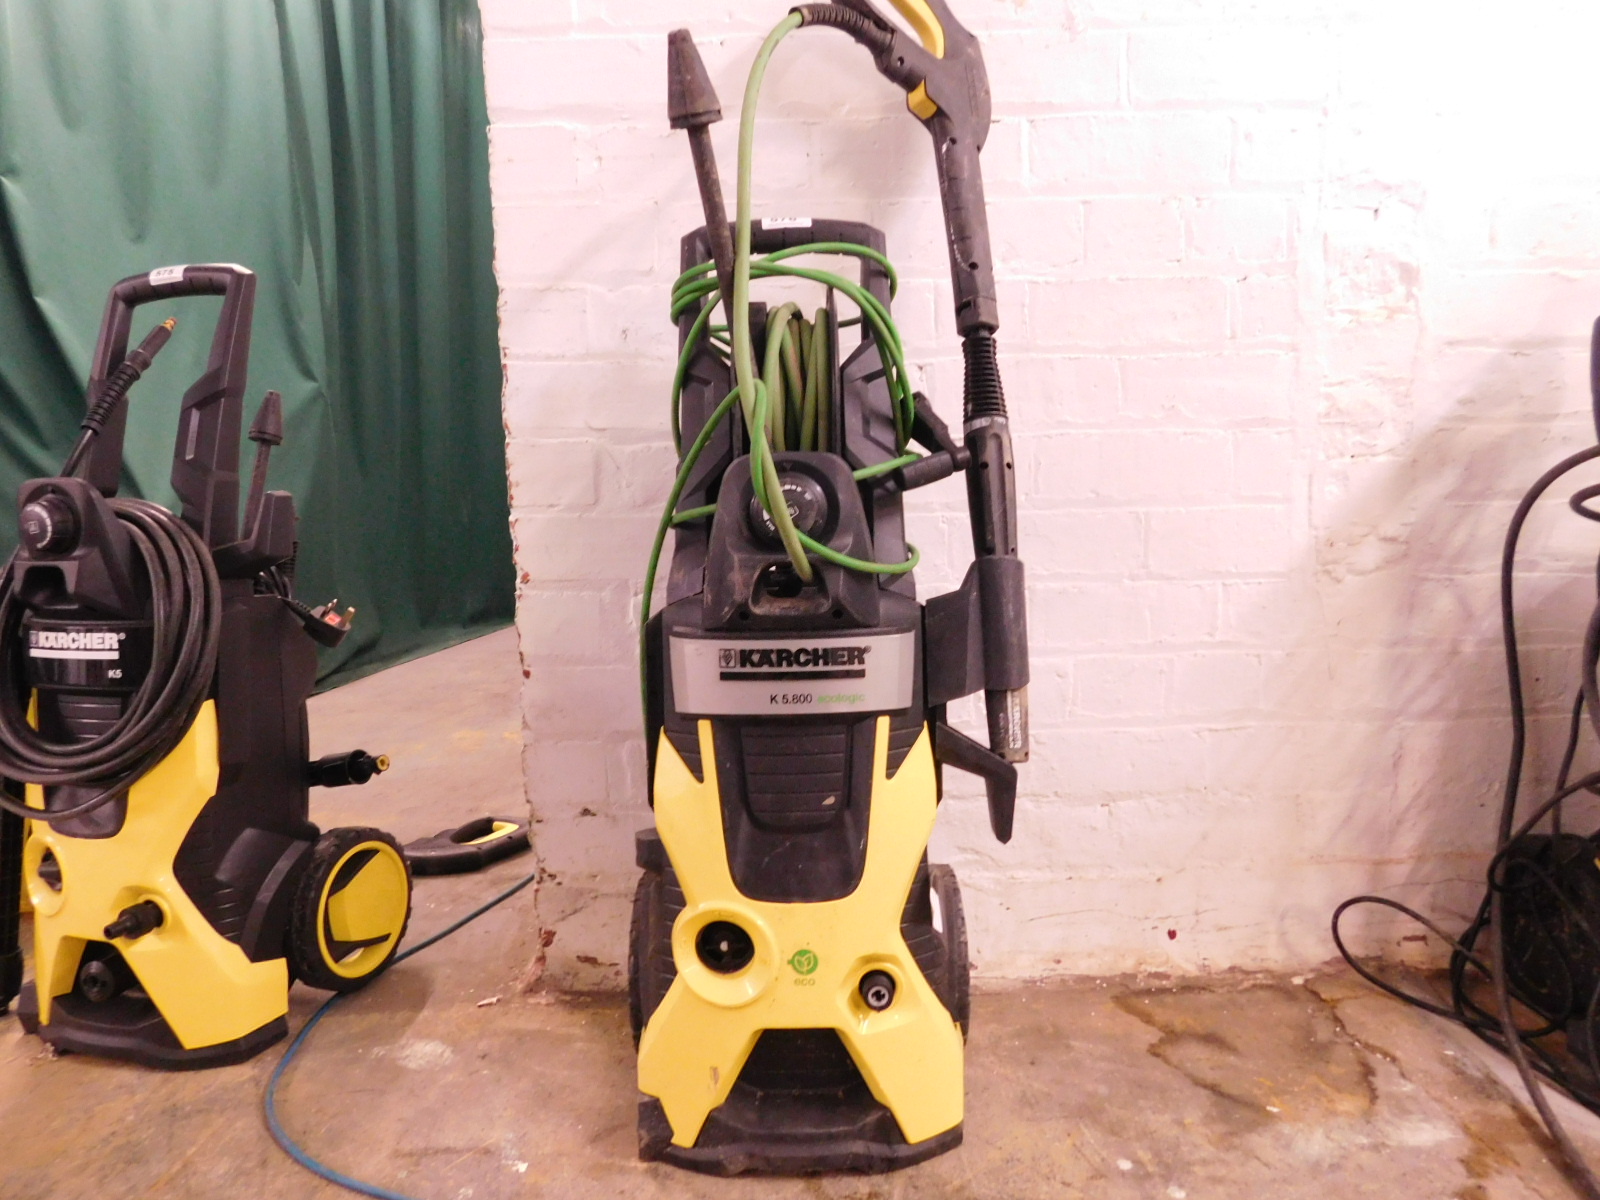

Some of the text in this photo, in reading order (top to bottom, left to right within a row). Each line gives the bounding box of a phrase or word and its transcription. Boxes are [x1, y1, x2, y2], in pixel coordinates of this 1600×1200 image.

[769, 693, 865, 705] K 5.800 ecologic
[794, 978, 815, 986] eco
